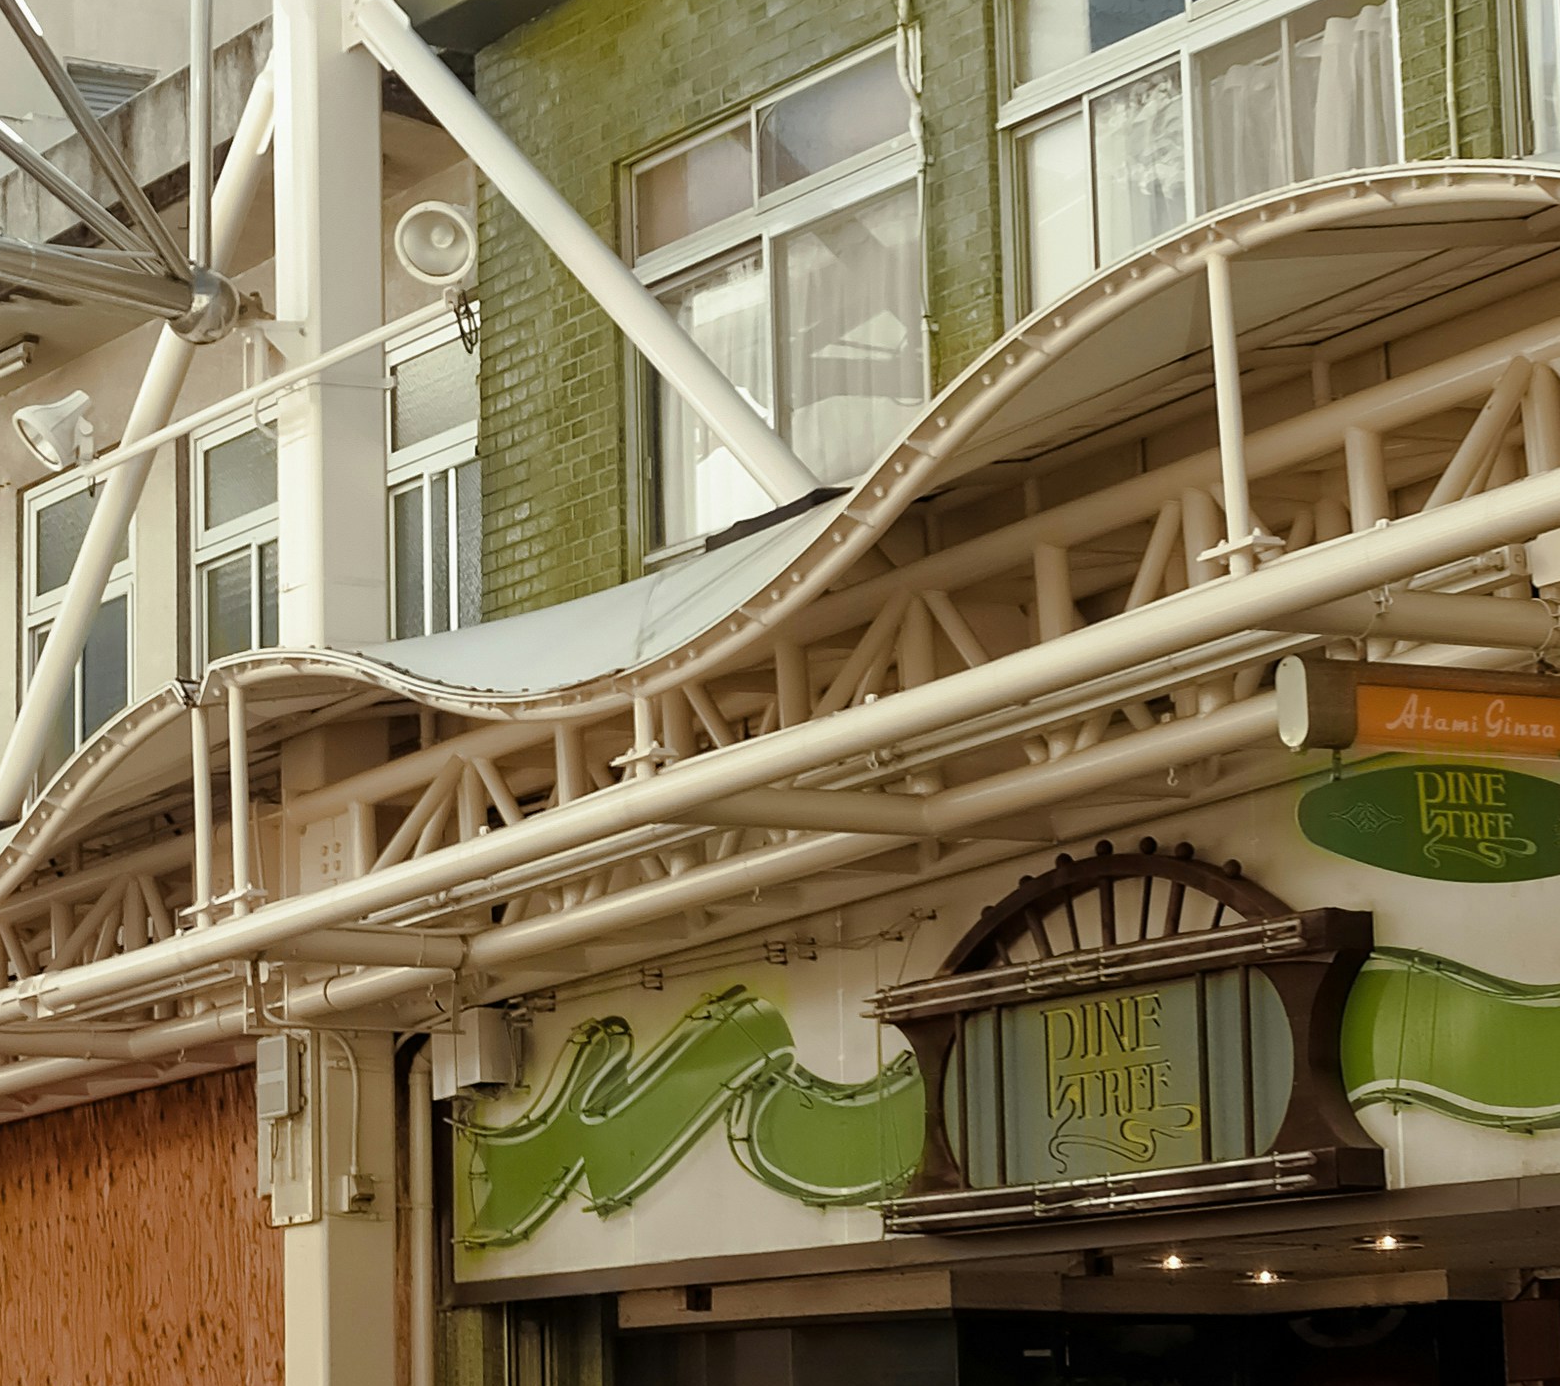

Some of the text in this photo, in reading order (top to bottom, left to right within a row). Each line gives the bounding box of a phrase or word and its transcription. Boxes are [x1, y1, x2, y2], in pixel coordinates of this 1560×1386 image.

[1385, 692, 1556, 740] Atami Ginza
[1415, 770, 1507, 820] PINE
[1431, 809, 1514, 840] TREE
[1042, 993, 1163, 1081] PINE
[1058, 1061, 1172, 1120] TREE
